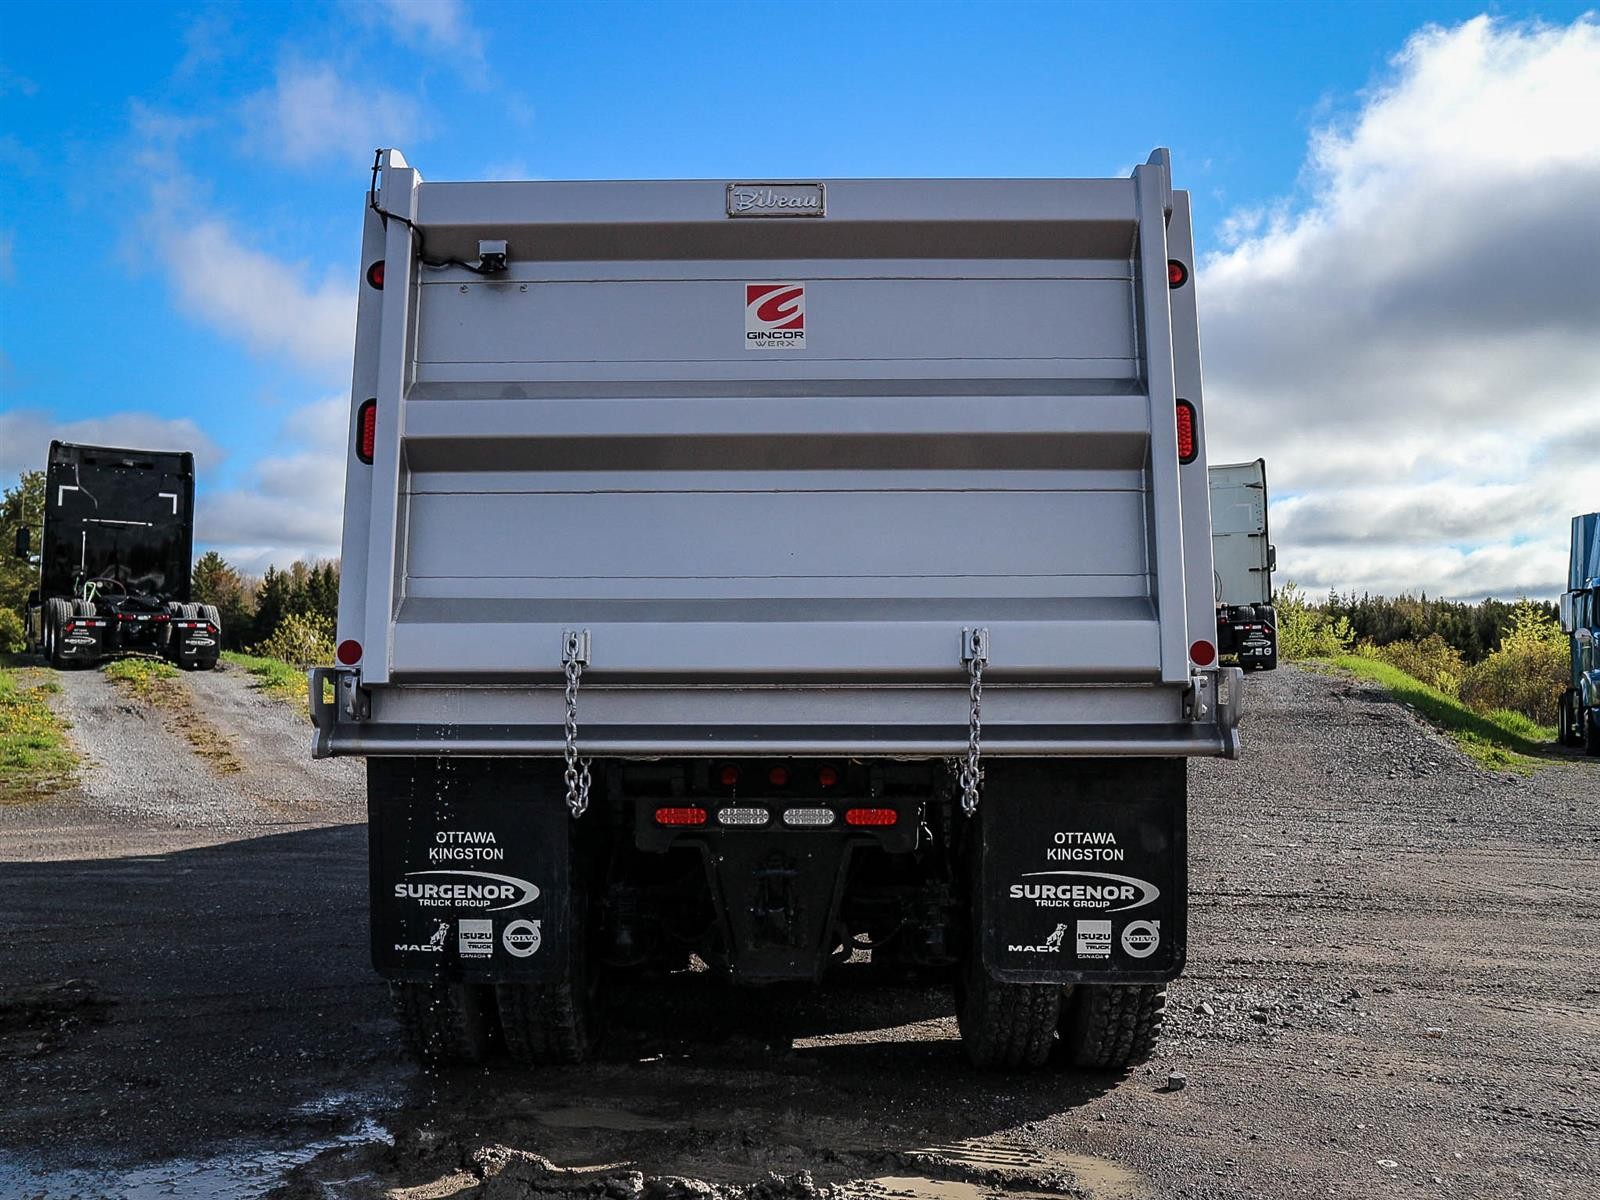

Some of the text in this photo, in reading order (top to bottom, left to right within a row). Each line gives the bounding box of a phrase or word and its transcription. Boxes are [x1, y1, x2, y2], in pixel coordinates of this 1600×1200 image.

[735, 189, 818, 211] Bibeau
[747, 331, 804, 339] GINCOR
[436, 831, 496, 844] OTTAWA
[1054, 832, 1116, 844] OTTAWA
[429, 848, 503, 860] KINGSTON
[1047, 849, 1124, 861] KINGSTON
[394, 884, 515, 899] SURGENOR
[1010, 885, 1135, 900] SURGENOR
[460, 932, 492, 940] ISUZU
[394, 944, 444, 952] MACK
